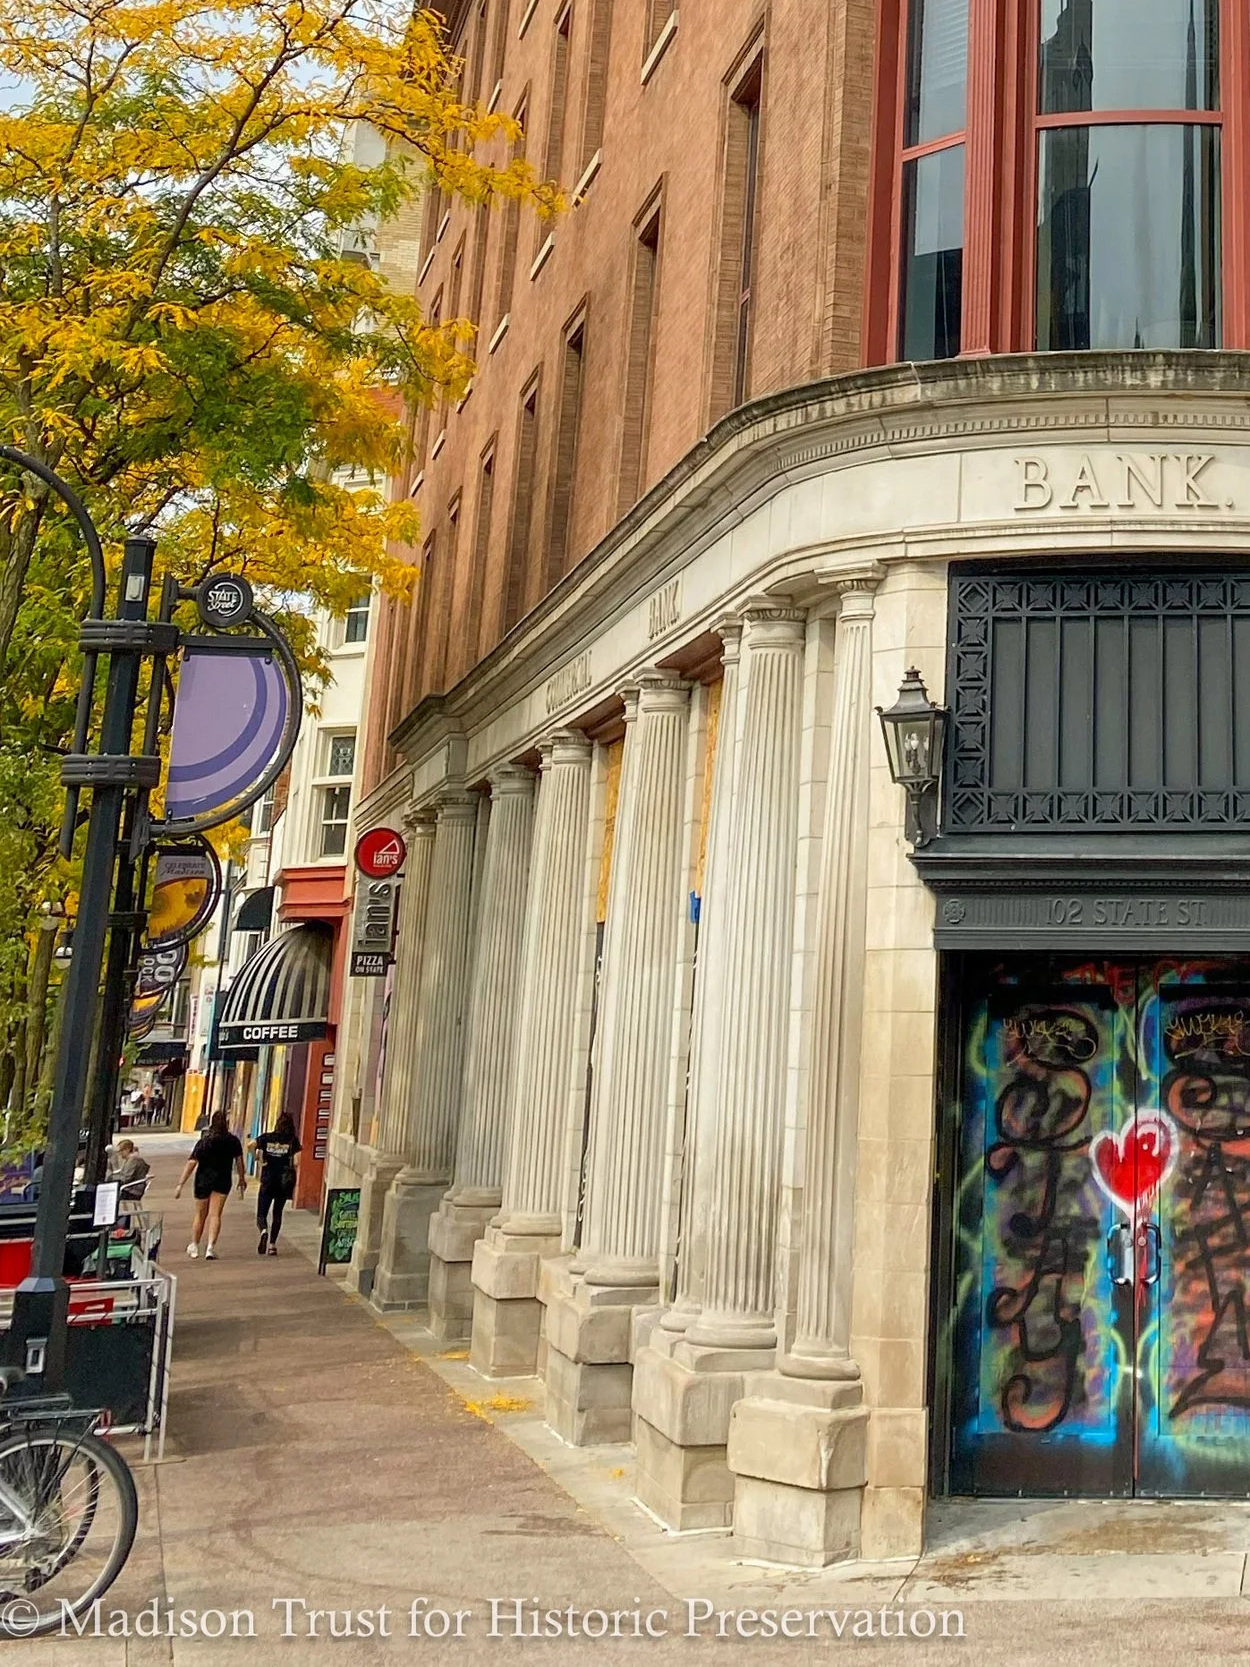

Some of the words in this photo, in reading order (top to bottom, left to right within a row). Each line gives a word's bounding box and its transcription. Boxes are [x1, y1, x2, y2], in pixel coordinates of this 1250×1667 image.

[208, 589, 238, 602] STATE
[373, 853, 398, 865] ian's
[357, 882, 391, 947] ian's
[1046, 898, 1083, 925] 102
[1094, 899, 1169, 926] STATE
[357, 955, 384, 966] PIZZA
[355, 965, 366, 973] ON
[367, 965, 384, 974] STATE
[243, 1025, 298, 1040] COFFEE
